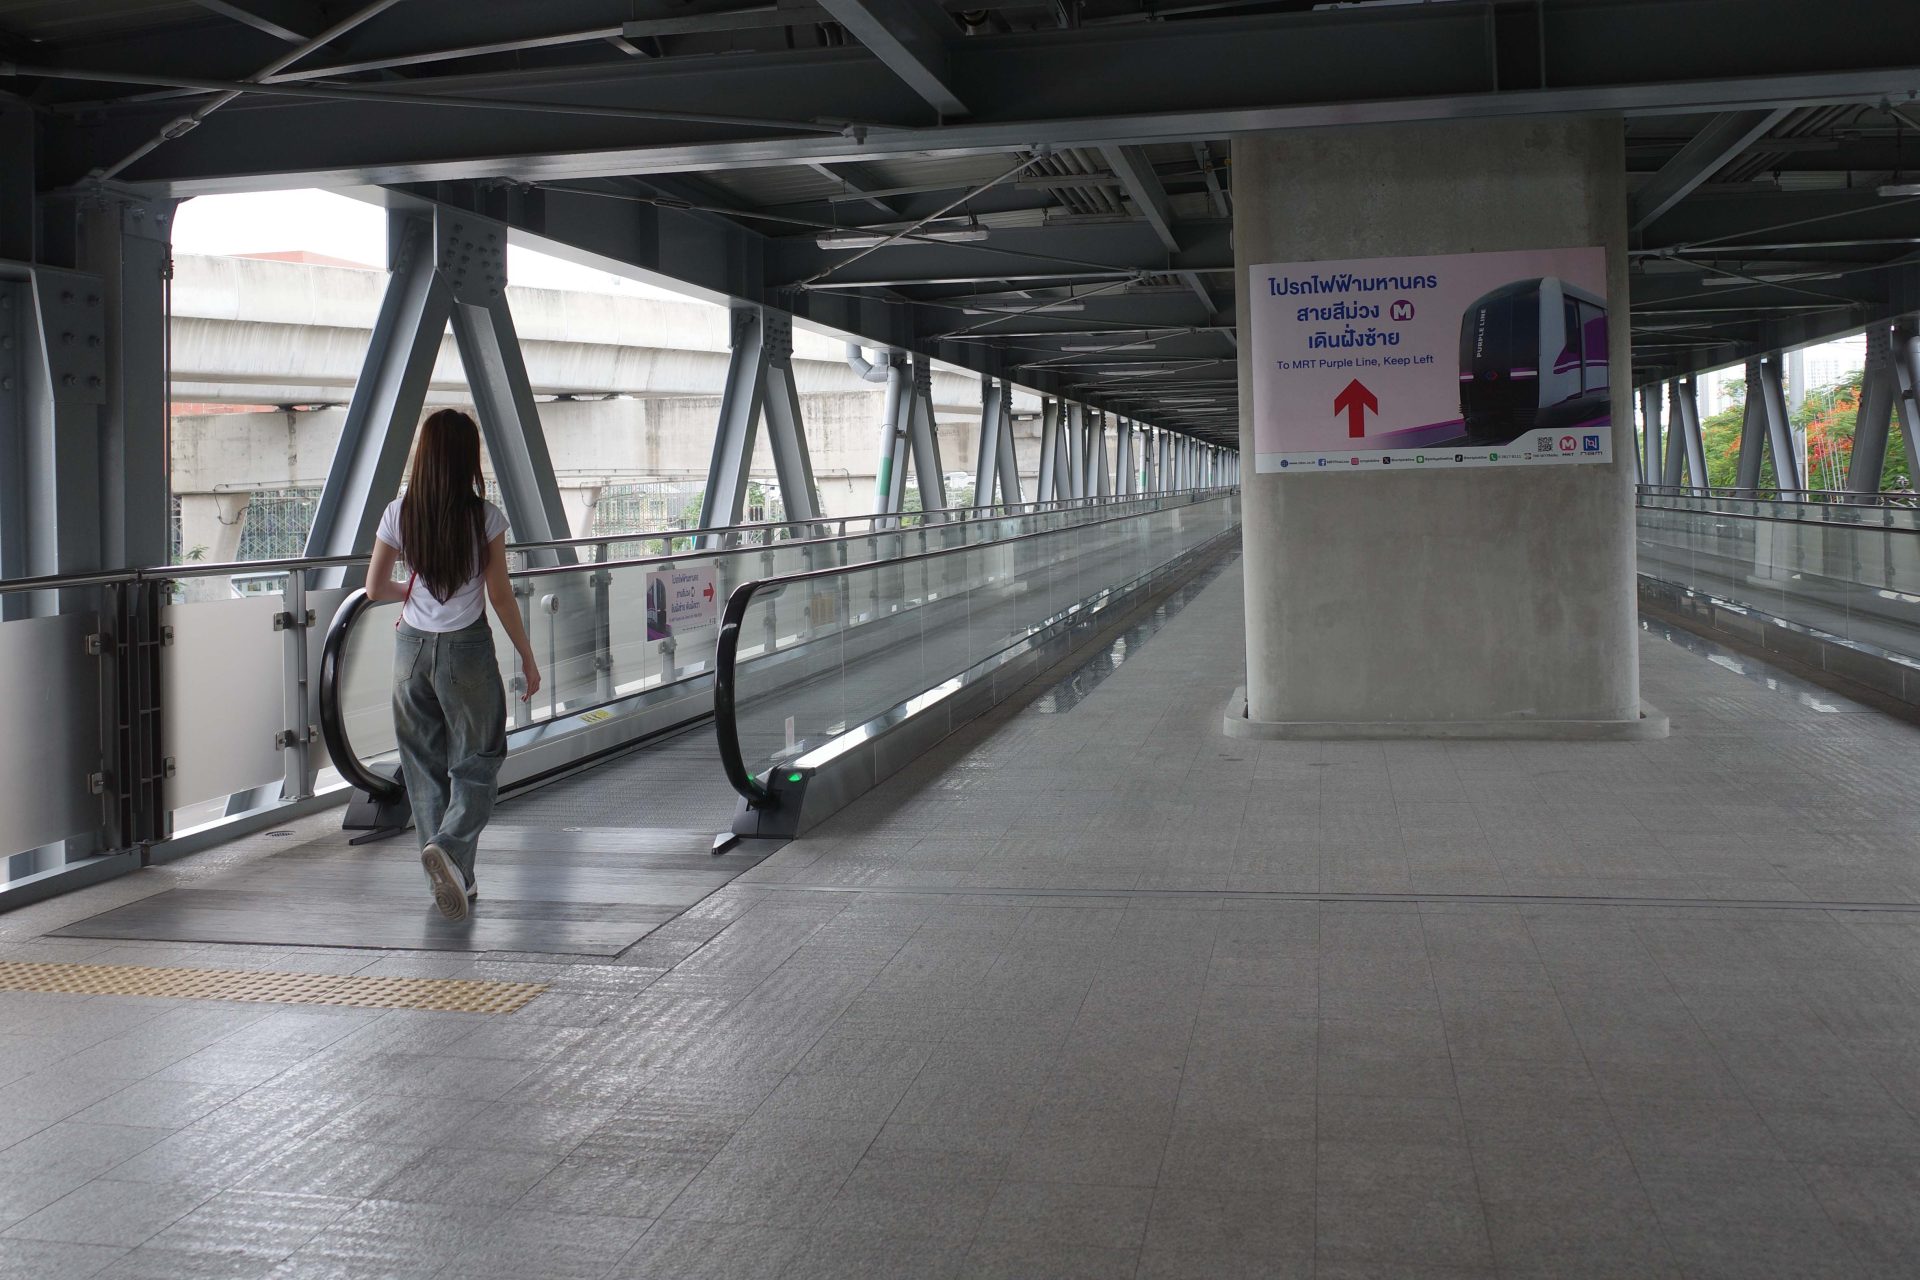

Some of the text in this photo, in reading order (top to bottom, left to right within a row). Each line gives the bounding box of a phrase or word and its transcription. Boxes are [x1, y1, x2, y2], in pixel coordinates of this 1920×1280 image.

[1268, 274, 1437, 296] ไปรถไฟฟ้ามหานคร
[1297, 301, 1380, 321] สายสีม่วง
[1308, 324, 1400, 349] เดินฝั่งซ้าย
[1476, 327, 1485, 358] PURPLE
[1277, 354, 1434, 369] To MRT Purple Line, Keep Left
